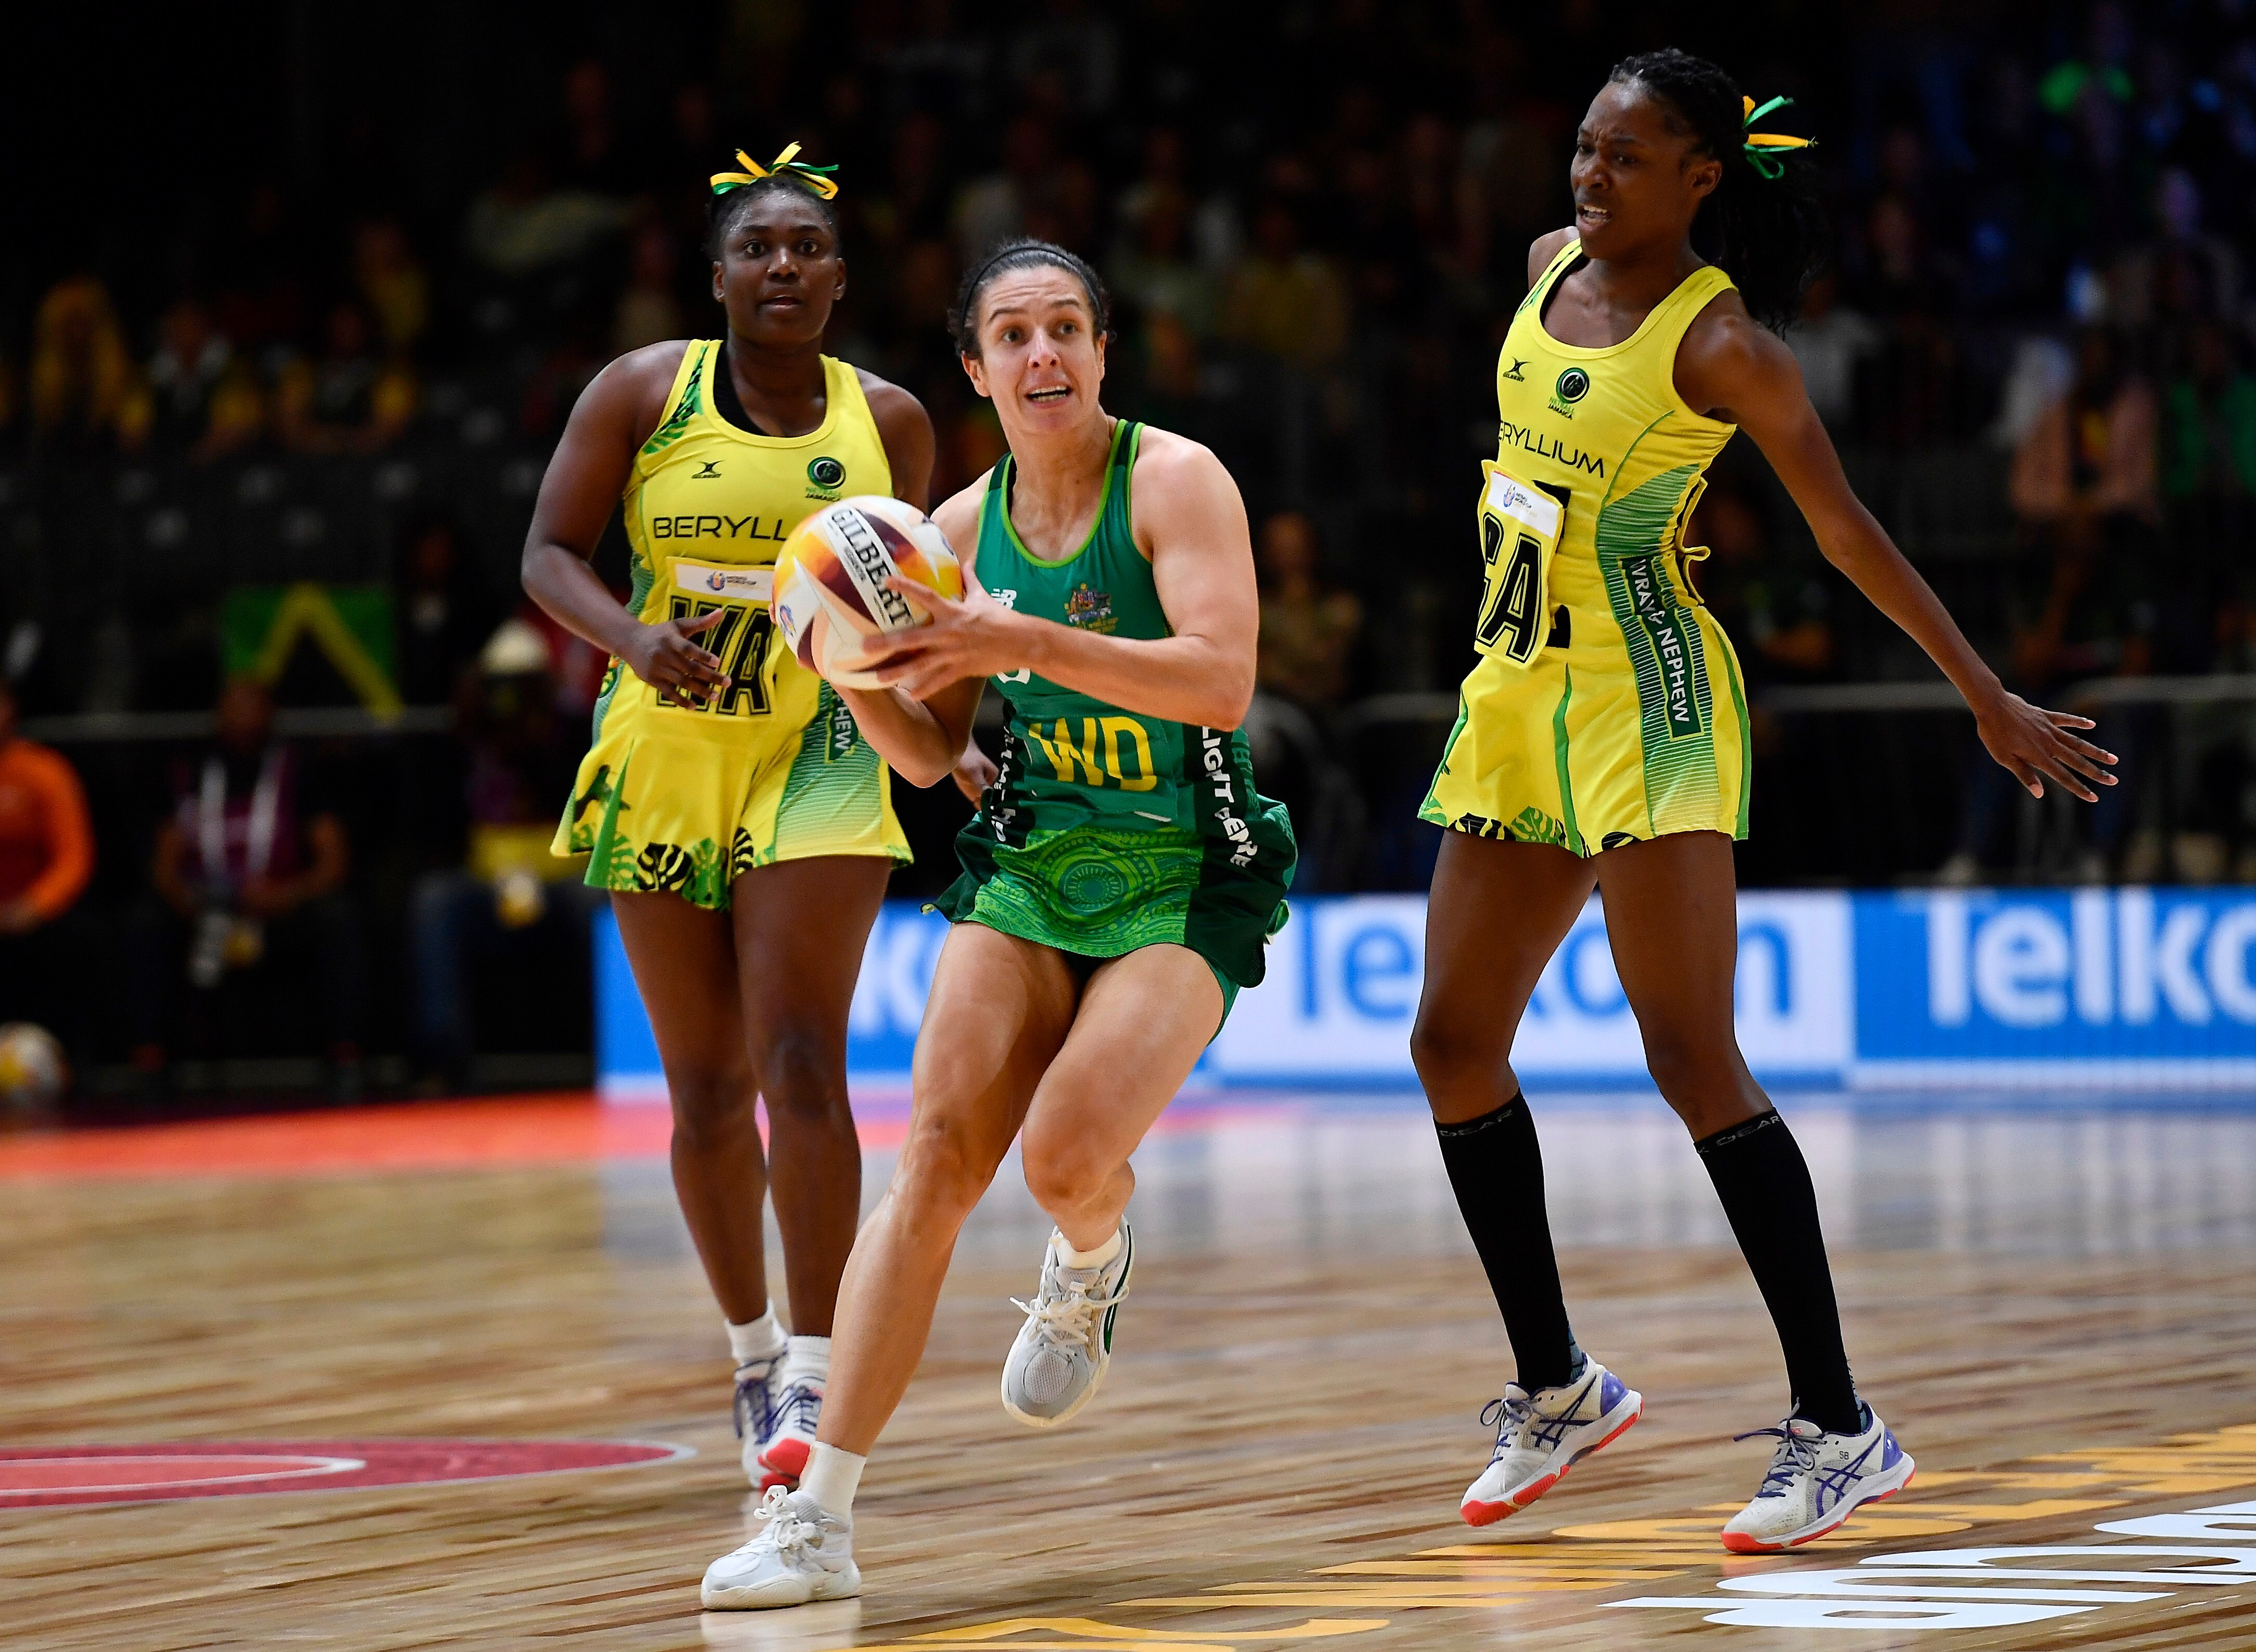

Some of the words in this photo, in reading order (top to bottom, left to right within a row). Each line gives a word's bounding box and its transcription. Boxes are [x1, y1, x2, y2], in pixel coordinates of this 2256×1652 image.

[1498, 420, 1604, 479] ERYLLIUM
[654, 516, 787, 540] BERYLL
[832, 507, 915, 626] GILBERT
[1630, 559, 1656, 613] WRAY
[1647, 610, 1665, 624] &
[1657, 627, 1690, 722] NEPHEW
[1029, 716, 1157, 791] WD
[1839, 1450, 1849, 1460] SB
[1597, 1545, 2256, 1629] CUP
